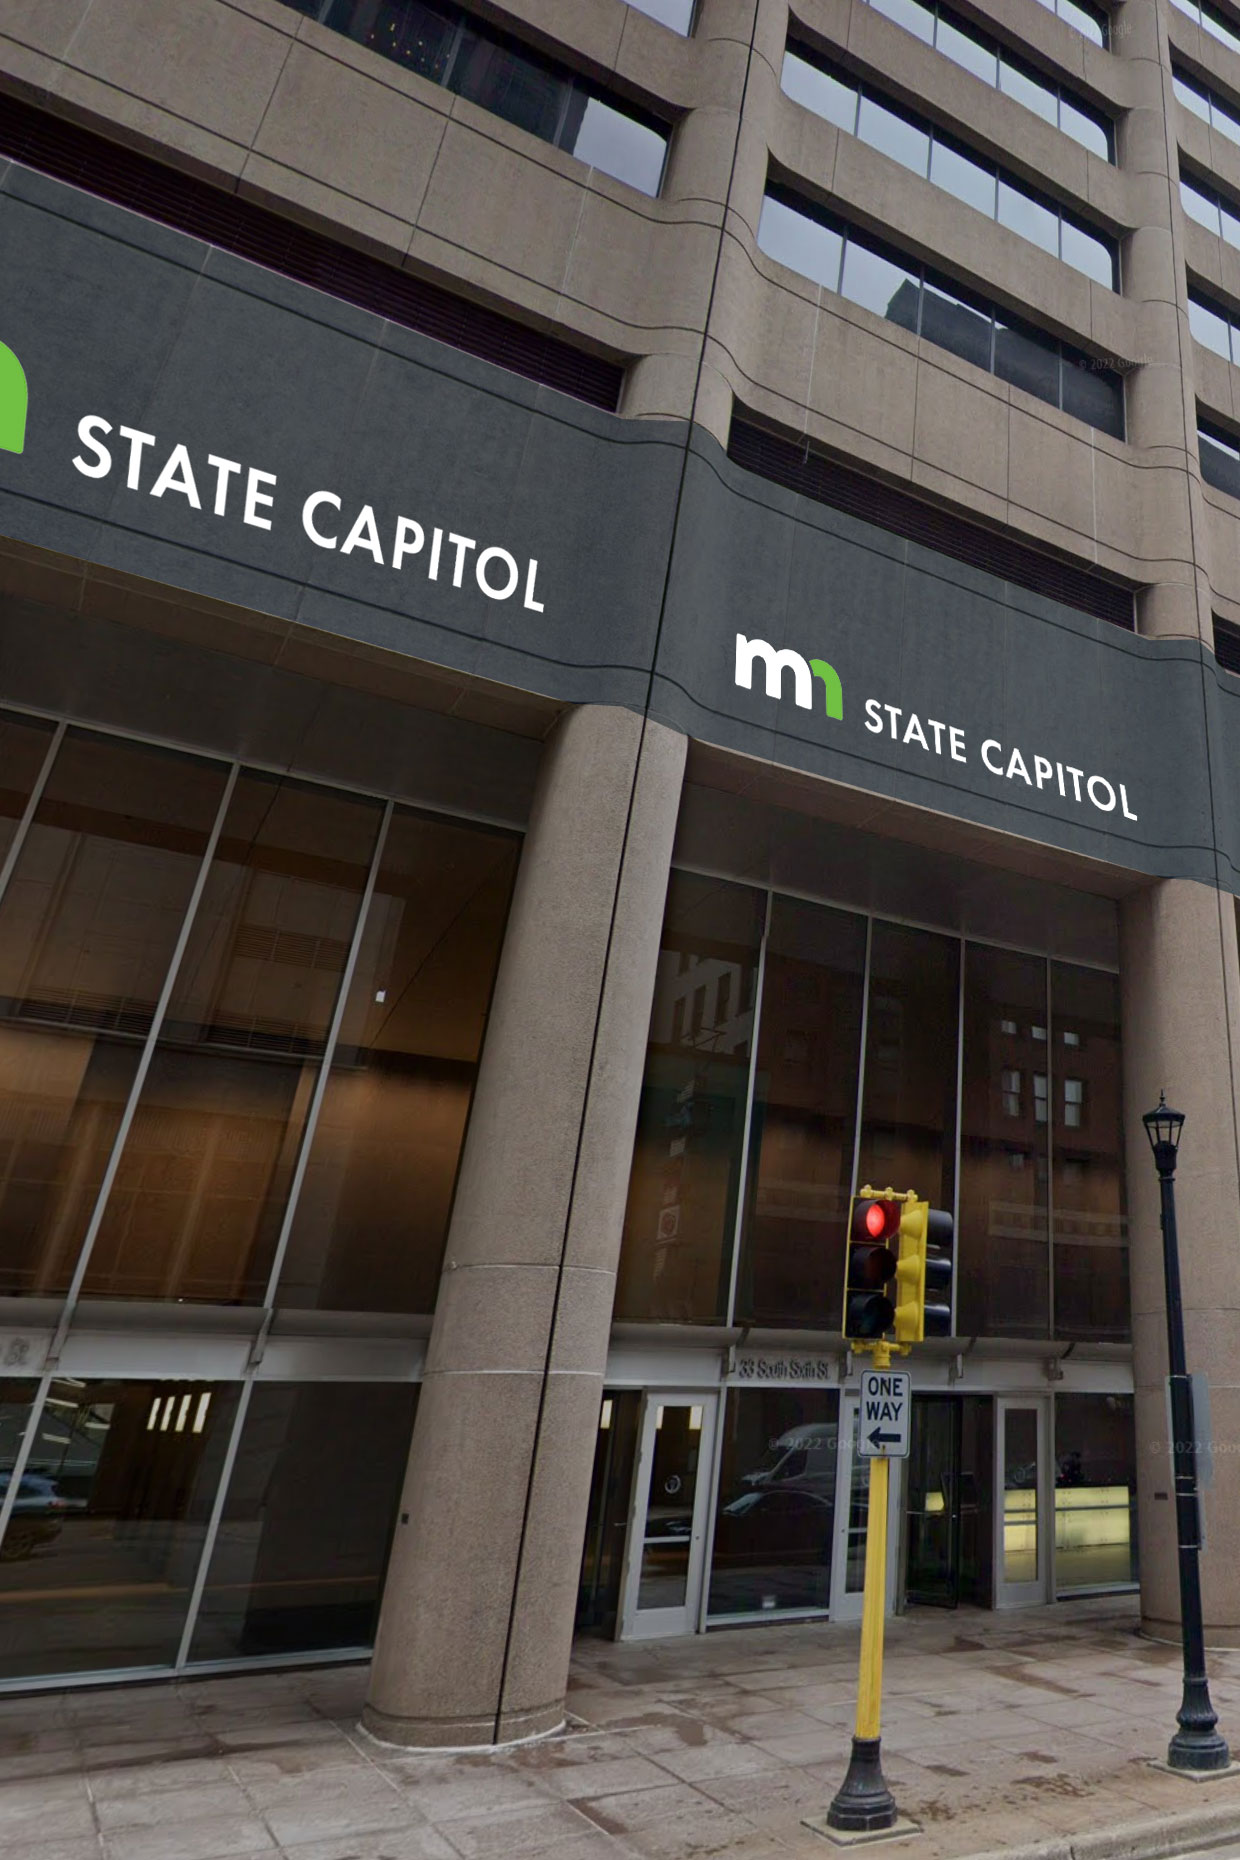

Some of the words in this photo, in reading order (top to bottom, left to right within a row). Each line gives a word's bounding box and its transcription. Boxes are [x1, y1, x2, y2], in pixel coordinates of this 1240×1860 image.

[72, 415, 277, 531] STATE
[302, 491, 545, 613] CAPITOL
[864, 699, 967, 764] STATE
[981, 740, 1138, 821] CAPITOL
[739, 1359, 755, 1378] 33
[868, 1376, 903, 1397] ONE
[866, 1401, 903, 1422] WAY
